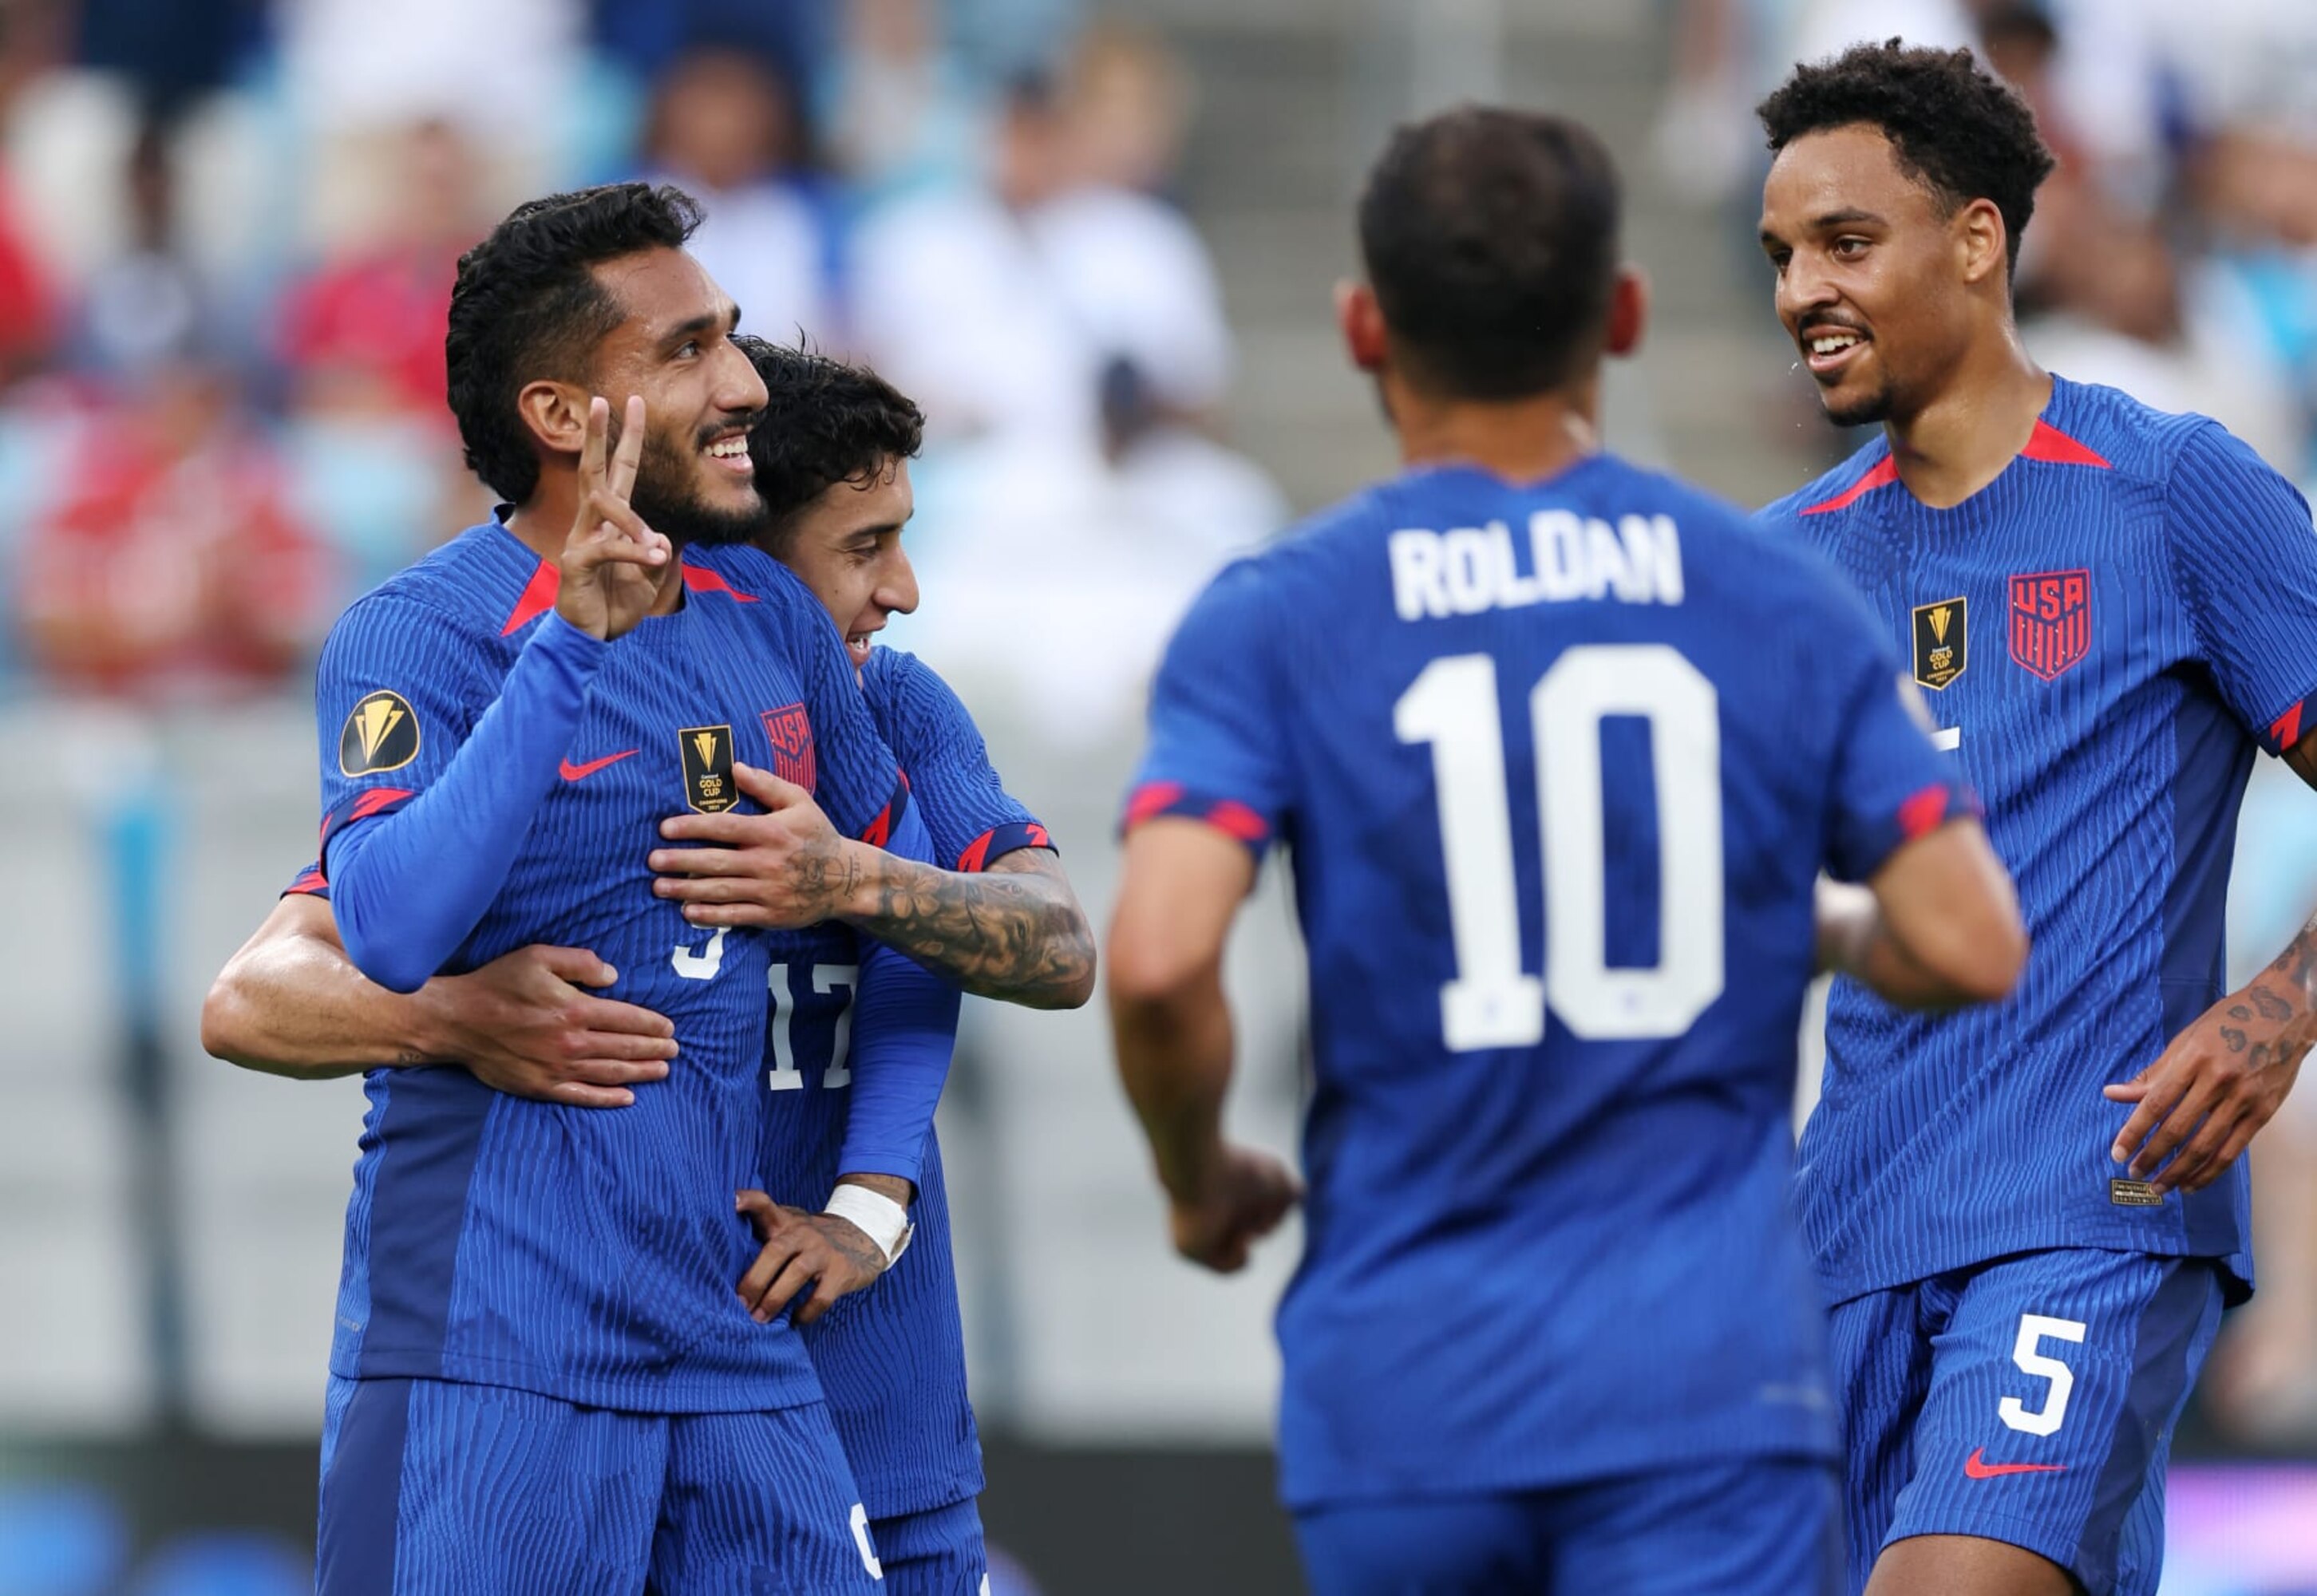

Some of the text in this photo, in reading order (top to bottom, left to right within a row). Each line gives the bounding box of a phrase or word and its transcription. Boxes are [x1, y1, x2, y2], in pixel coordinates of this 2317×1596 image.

[1388, 508, 1685, 622] ROLDAN
[2016, 576, 2084, 621] USA
[768, 711, 809, 755] USA
[699, 778, 722, 788] GOLD
[703, 787, 721, 797] CUP
[1394, 643, 1725, 1053] 10
[767, 962, 860, 1091] 17
[1998, 1314, 2086, 1437] 5
